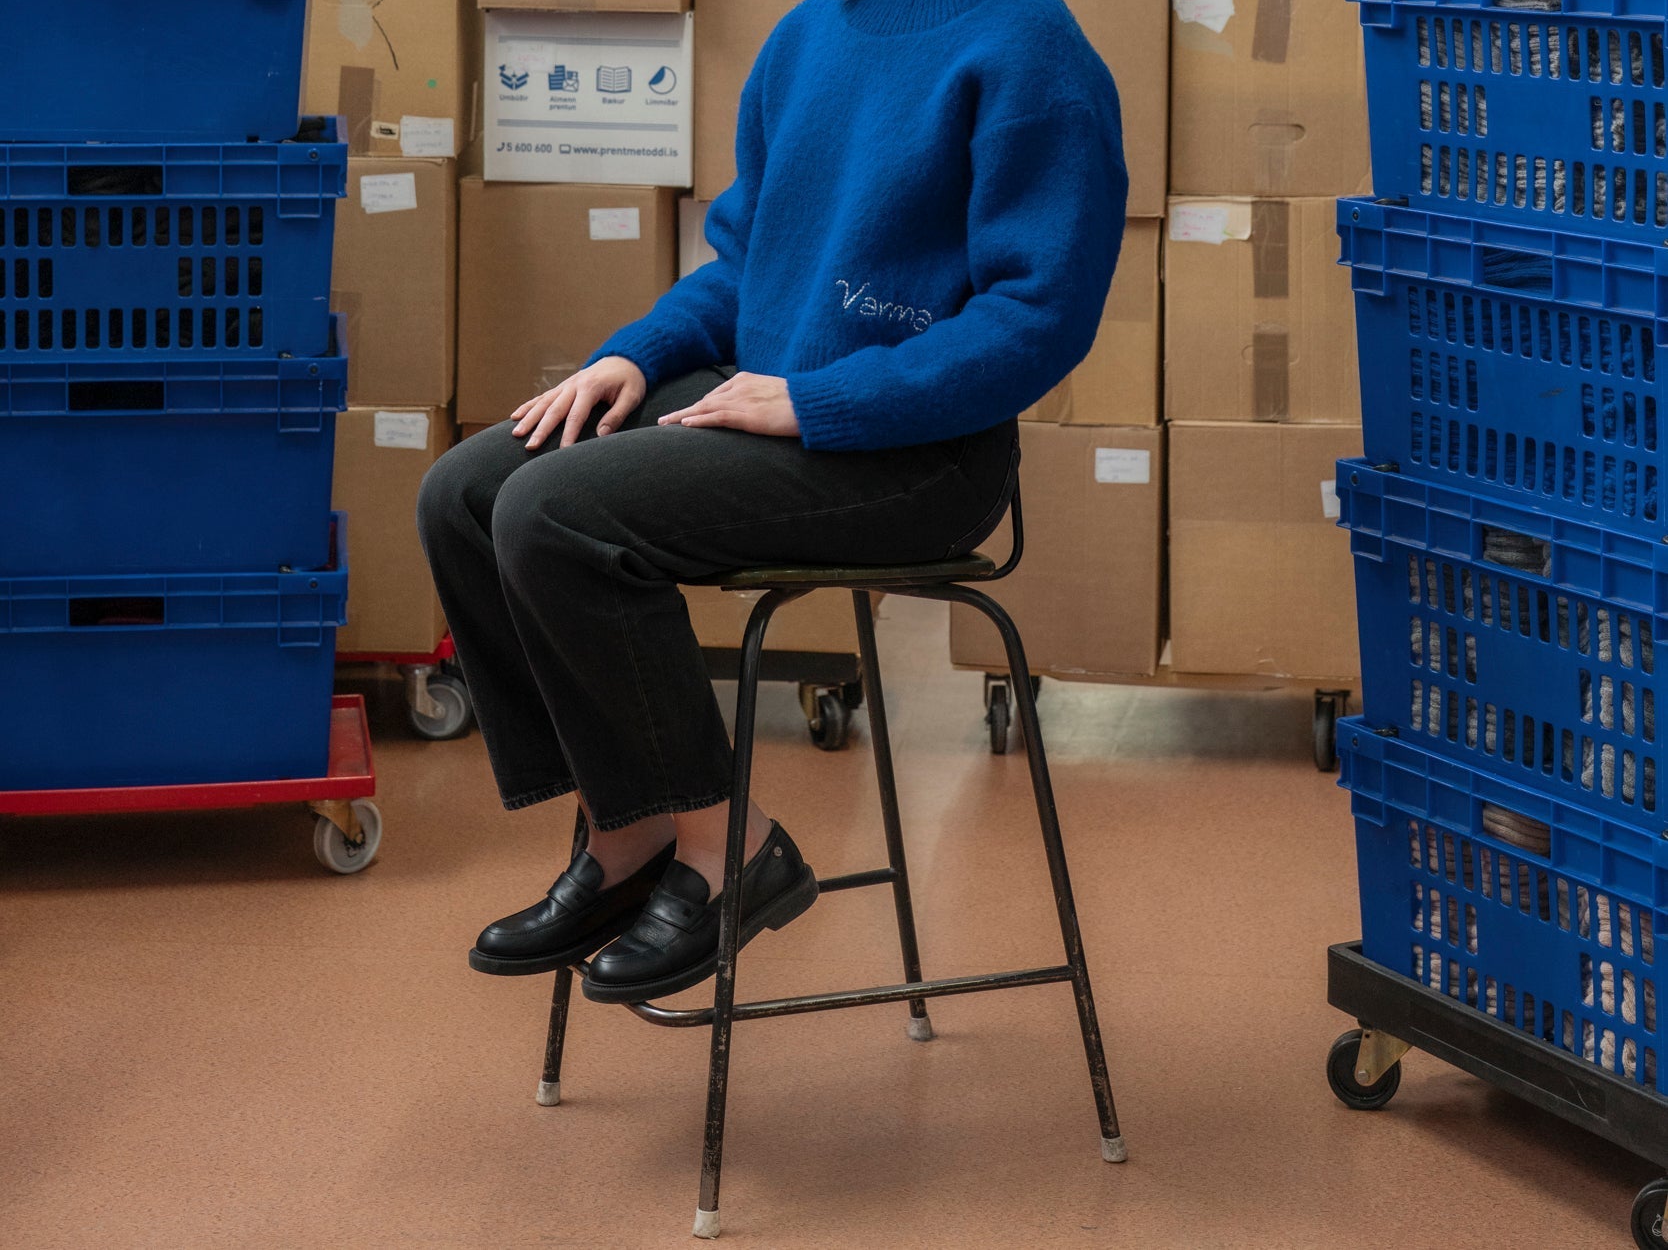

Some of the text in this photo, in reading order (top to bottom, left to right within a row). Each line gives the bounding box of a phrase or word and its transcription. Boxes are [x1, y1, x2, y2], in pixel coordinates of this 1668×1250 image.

[515, 142, 532, 152] 600
[534, 143, 552, 153] 600
[835, 279, 932, 331] Varma
